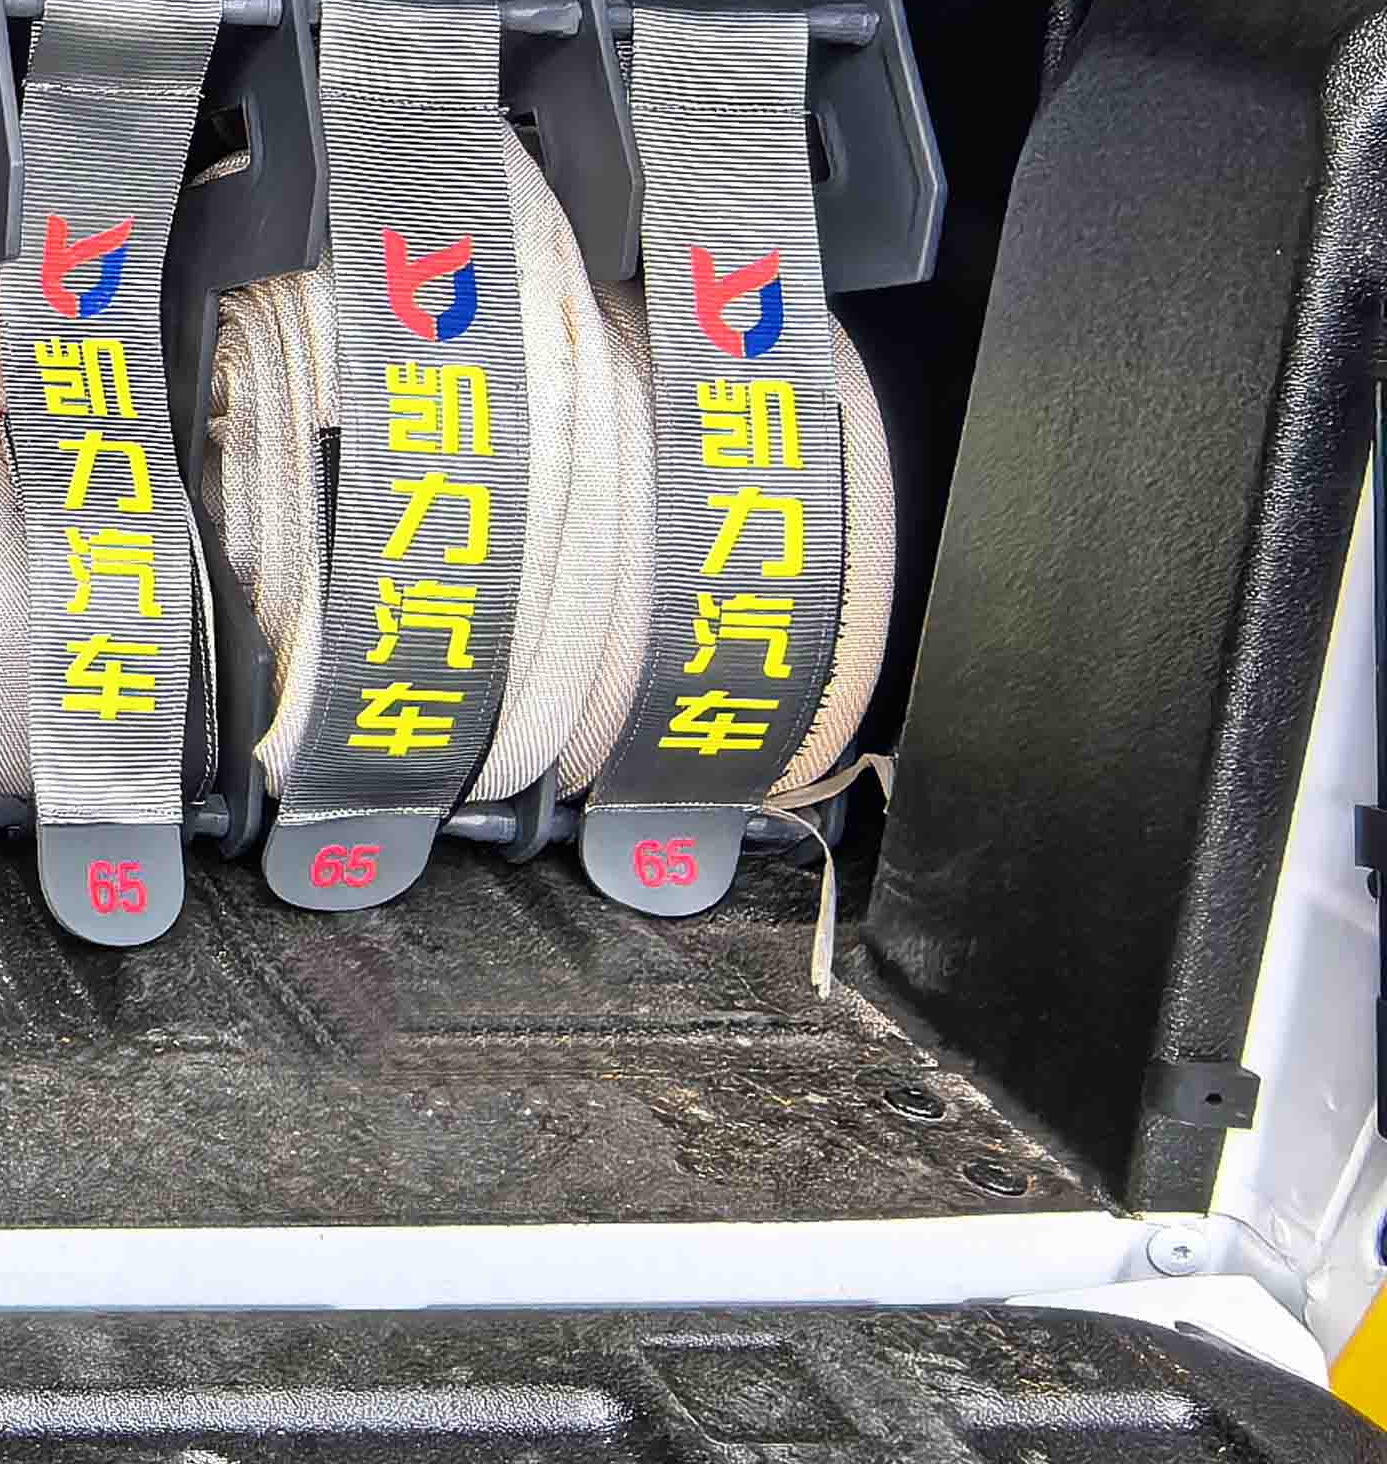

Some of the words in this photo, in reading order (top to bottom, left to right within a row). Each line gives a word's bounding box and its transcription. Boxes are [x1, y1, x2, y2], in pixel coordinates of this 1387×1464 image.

[36, 338, 162, 721] 凯力汽车
[348, 362, 492, 756] 凯力汽车
[656, 379, 805, 755] 凯力汽车
[88, 860, 148, 915] 65
[310, 844, 381, 889] 65
[633, 838, 699, 888] 65
